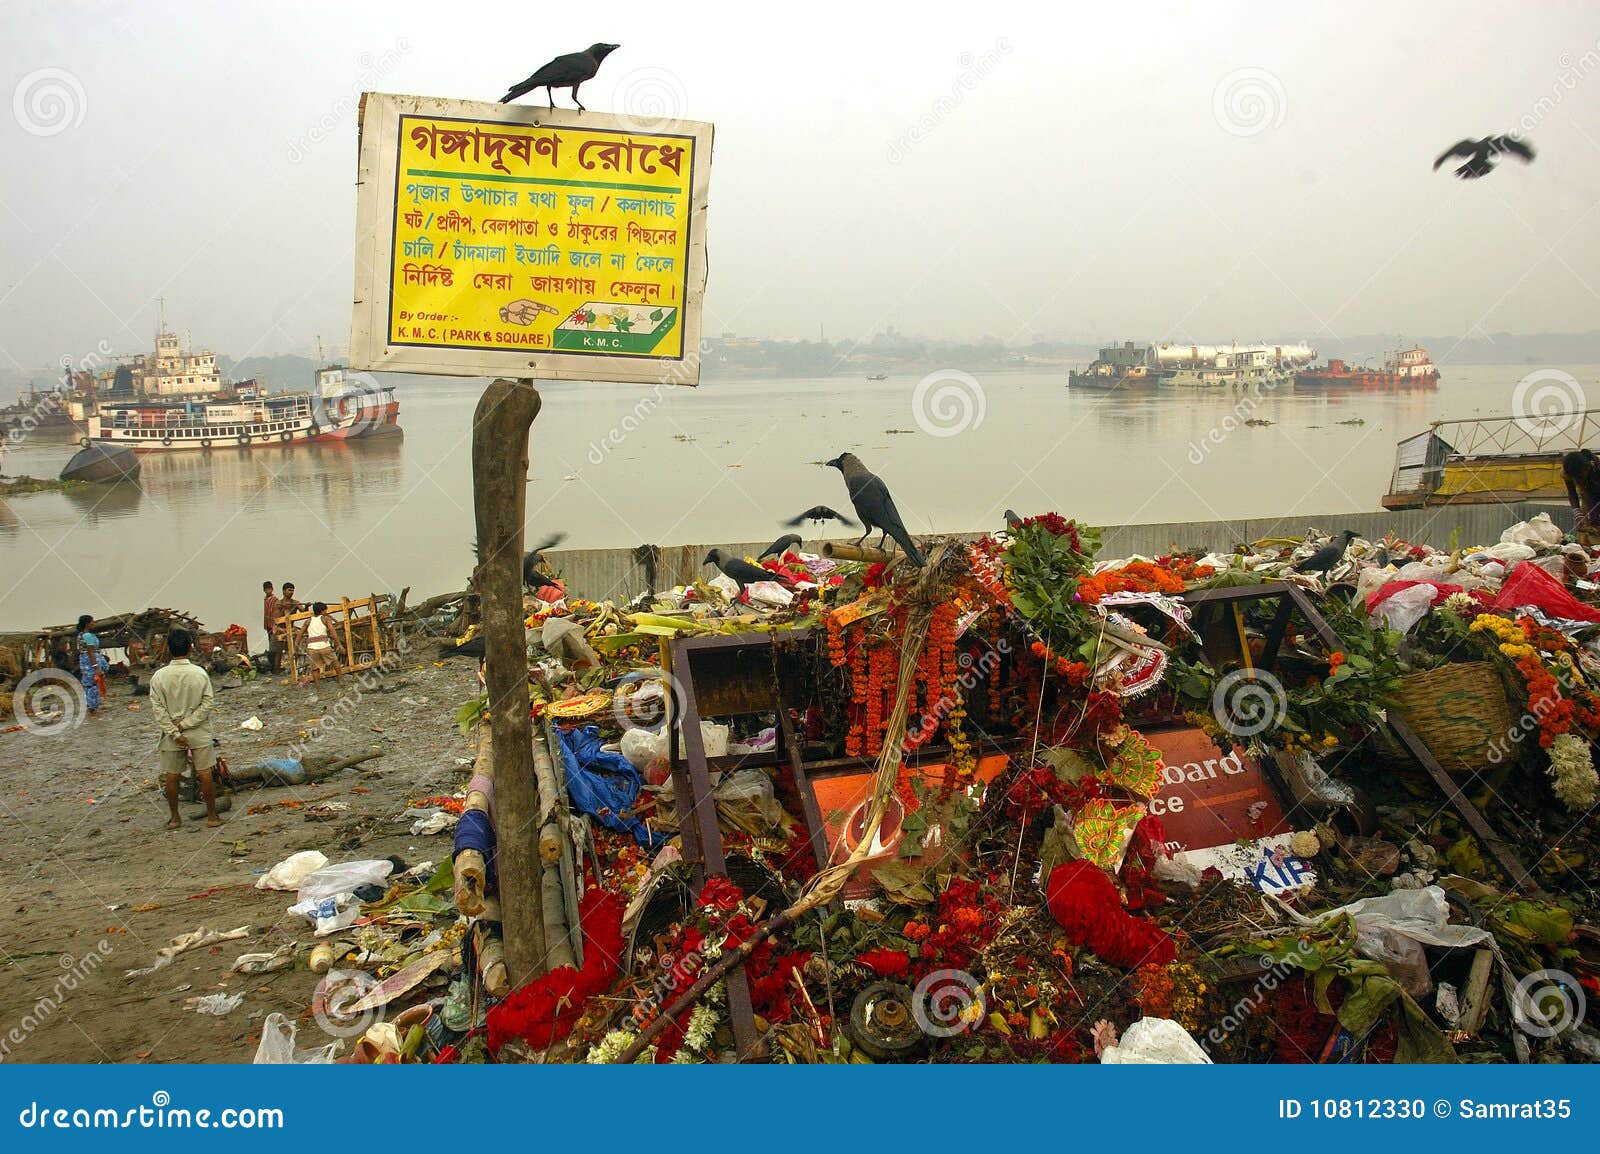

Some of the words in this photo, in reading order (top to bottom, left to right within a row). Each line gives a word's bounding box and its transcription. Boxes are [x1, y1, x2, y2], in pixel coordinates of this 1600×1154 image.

[411, 123, 563, 175] গঙ্গাদূষণ
[578, 138, 685, 176] রোধে
[406, 183, 450, 204] পূজার
[461, 182, 518, 207] উপাচার
[528, 191, 557, 209] যথা
[566, 194, 594, 216] ফুল
[616, 197, 676, 219] কলাগাছ
[481, 217, 539, 237] বেলপাতা
[548, 222, 558, 236] ও
[567, 216, 618, 245] ঠাকুরের
[626, 221, 677, 246] পিছনের
[403, 236, 434, 259] চালি
[453, 239, 506, 262] চাঁদমালা
[515, 243, 561, 266] ইত্যাদি
[568, 250, 602, 268] জলে
[610, 253, 626, 271] না
[635, 255, 674, 272] ফেলে
[402, 262, 454, 287] নির্দিষ্ট
[473, 272, 513, 291] ঘেরা
[530, 275, 595, 295] জায়গায়
[610, 281, 661, 304] ফেলুন
[400, 311, 414, 322] By
[417, 311, 448, 322] Order
[450, 329, 482, 342] PARK
[495, 330, 544, 344] SQUARE
[1159, 750, 1246, 786] board
